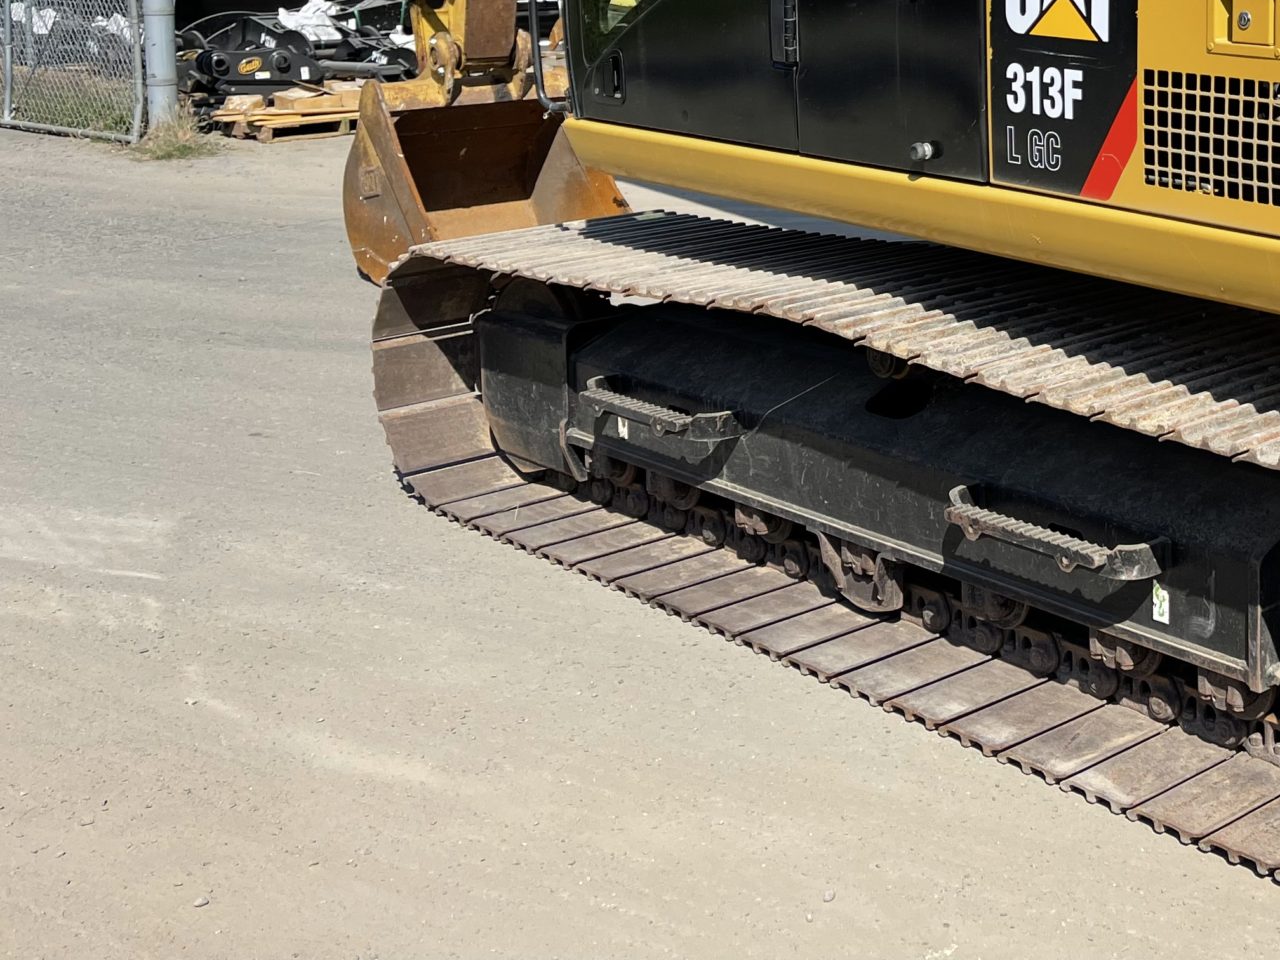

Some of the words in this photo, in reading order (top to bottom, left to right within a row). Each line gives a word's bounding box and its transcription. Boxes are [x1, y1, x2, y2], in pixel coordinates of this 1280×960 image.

[1006, 62, 1083, 120] 313F
[1006, 126, 1021, 165] L
[1027, 128, 1061, 171] GC
